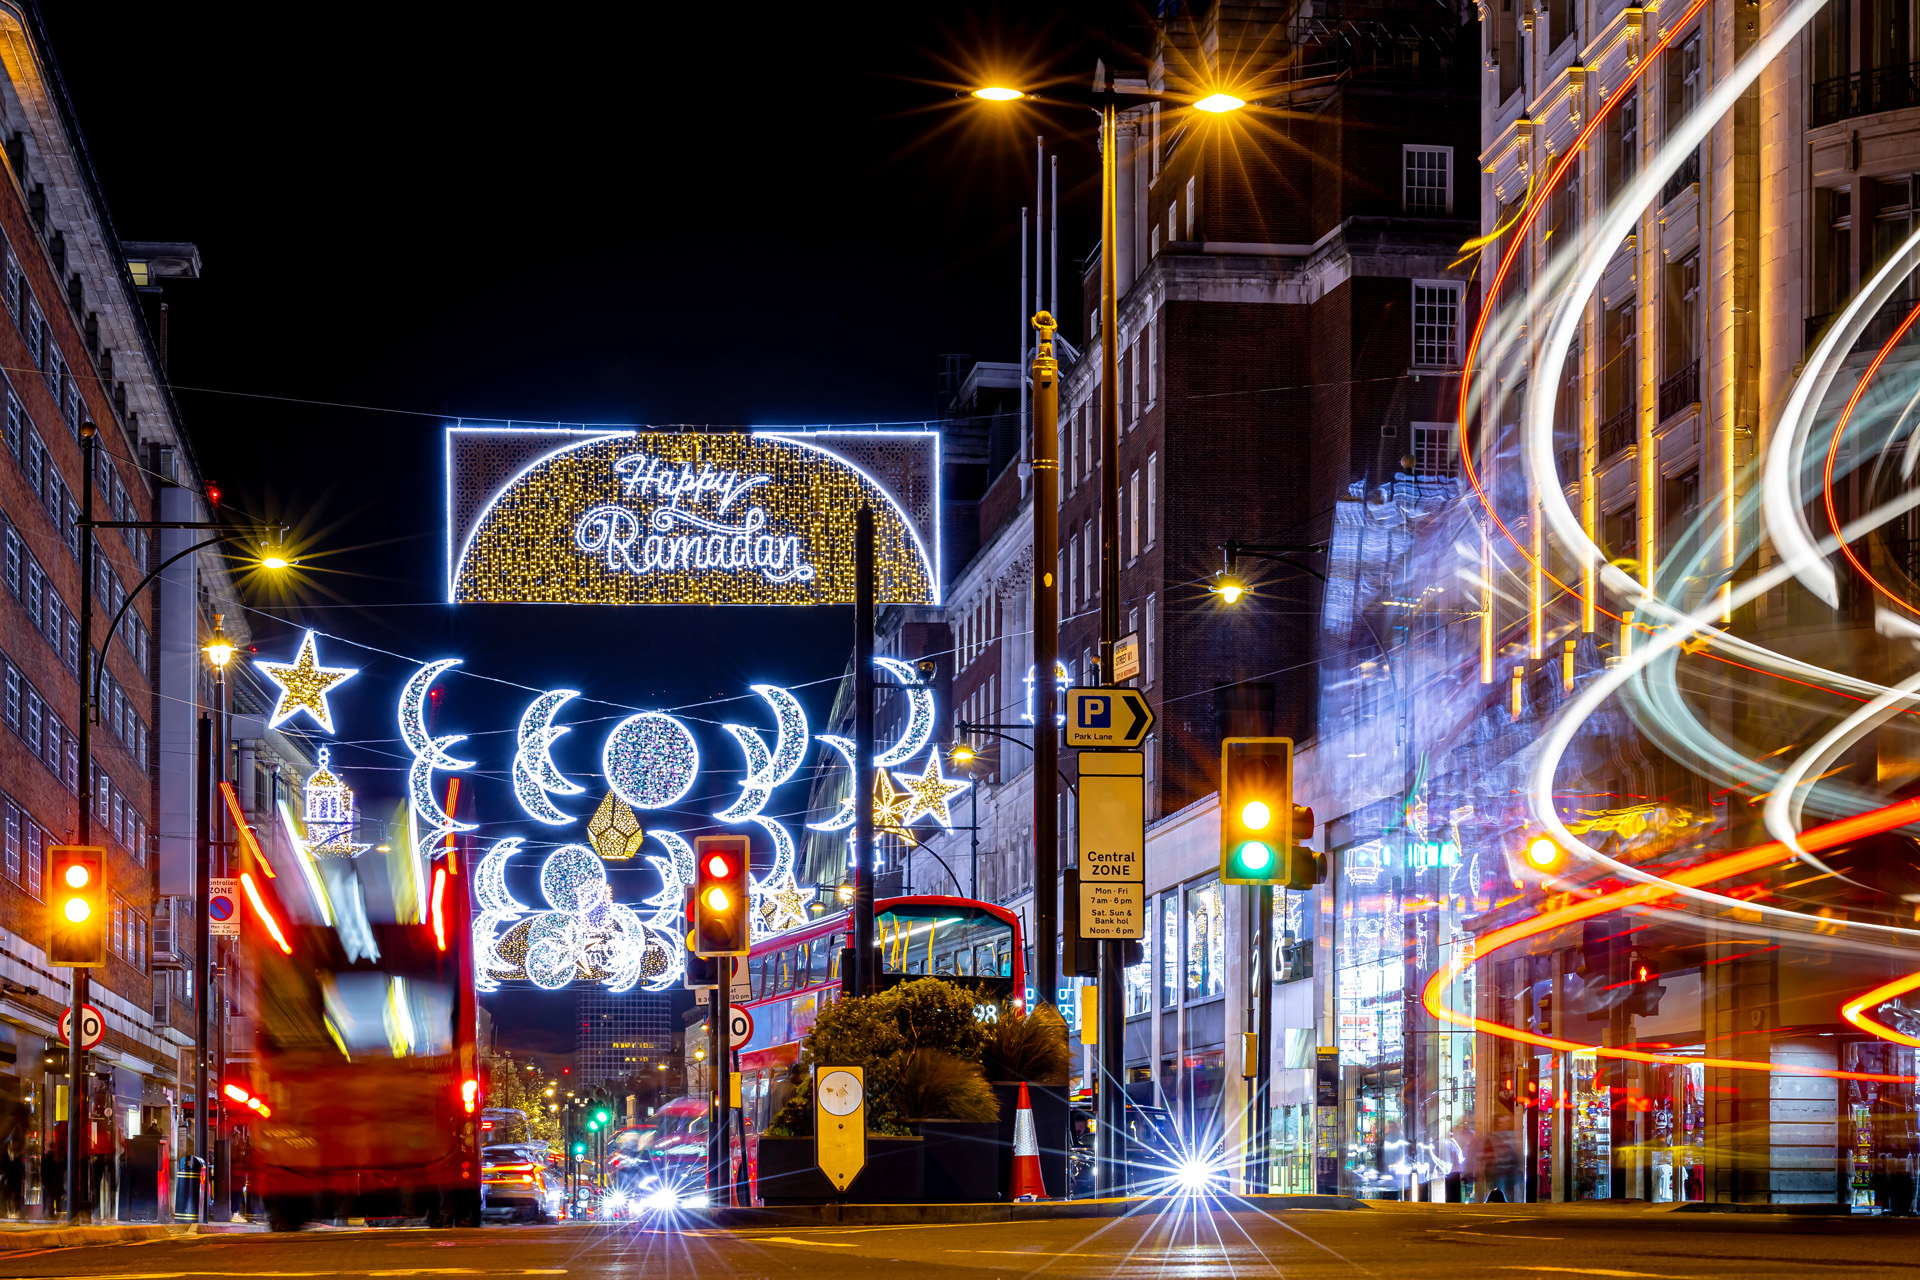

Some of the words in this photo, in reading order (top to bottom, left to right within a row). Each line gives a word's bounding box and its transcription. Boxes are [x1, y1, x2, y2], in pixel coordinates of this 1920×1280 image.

[614, 454, 769, 514] Happy
[576, 505, 814, 582] Ramadan
[1085, 699, 1104, 725] P
[1094, 733, 1113, 741] Lane
[1088, 851, 1135, 862] Central
[1092, 865, 1130, 875] ZONE
[972, 1004, 997, 1023] 98
